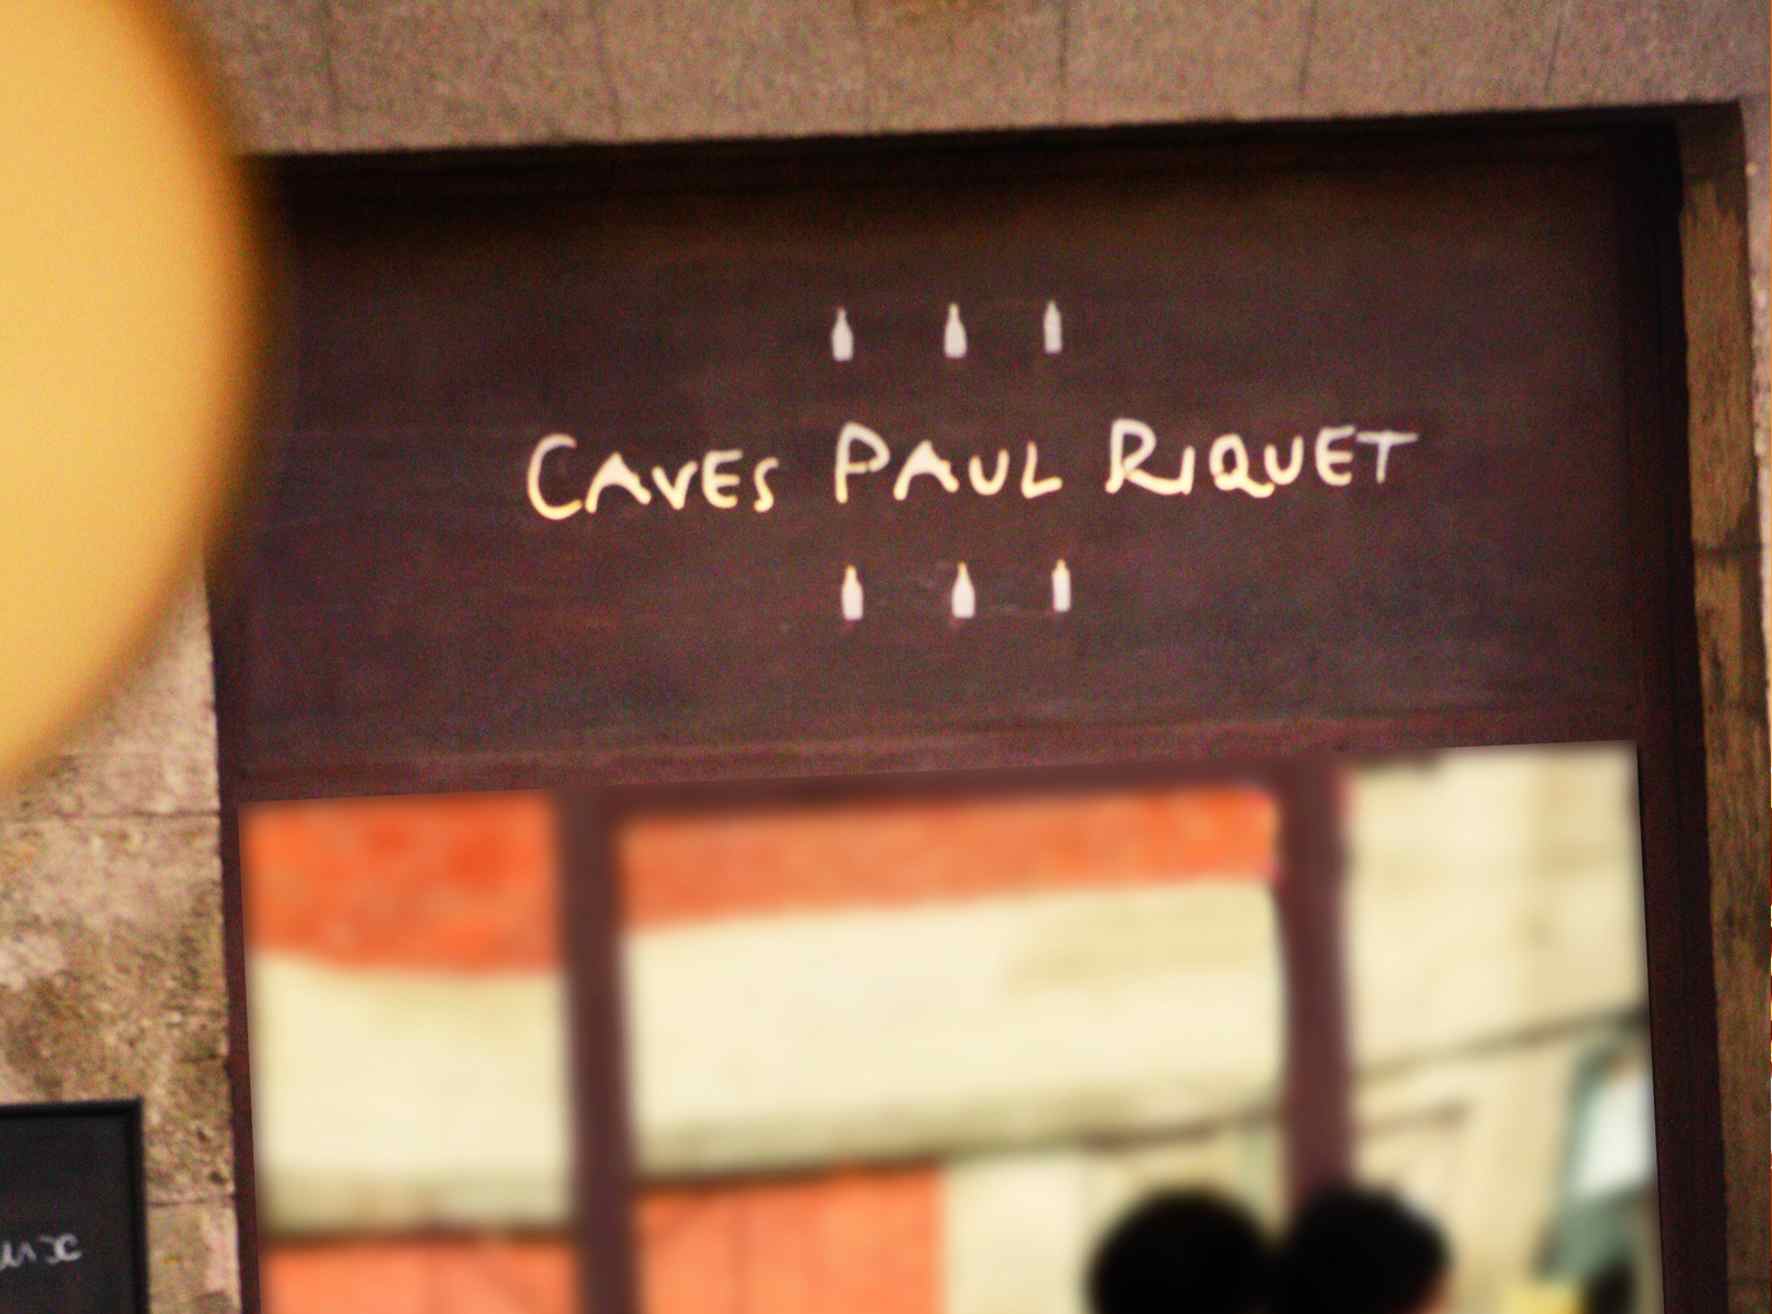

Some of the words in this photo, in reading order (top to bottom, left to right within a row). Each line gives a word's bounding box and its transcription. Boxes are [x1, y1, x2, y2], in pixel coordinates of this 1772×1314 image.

[526, 433, 779, 520] CAVES
[835, 422, 1063, 505] PAUL
[1104, 417, 1420, 499] RIQUET
